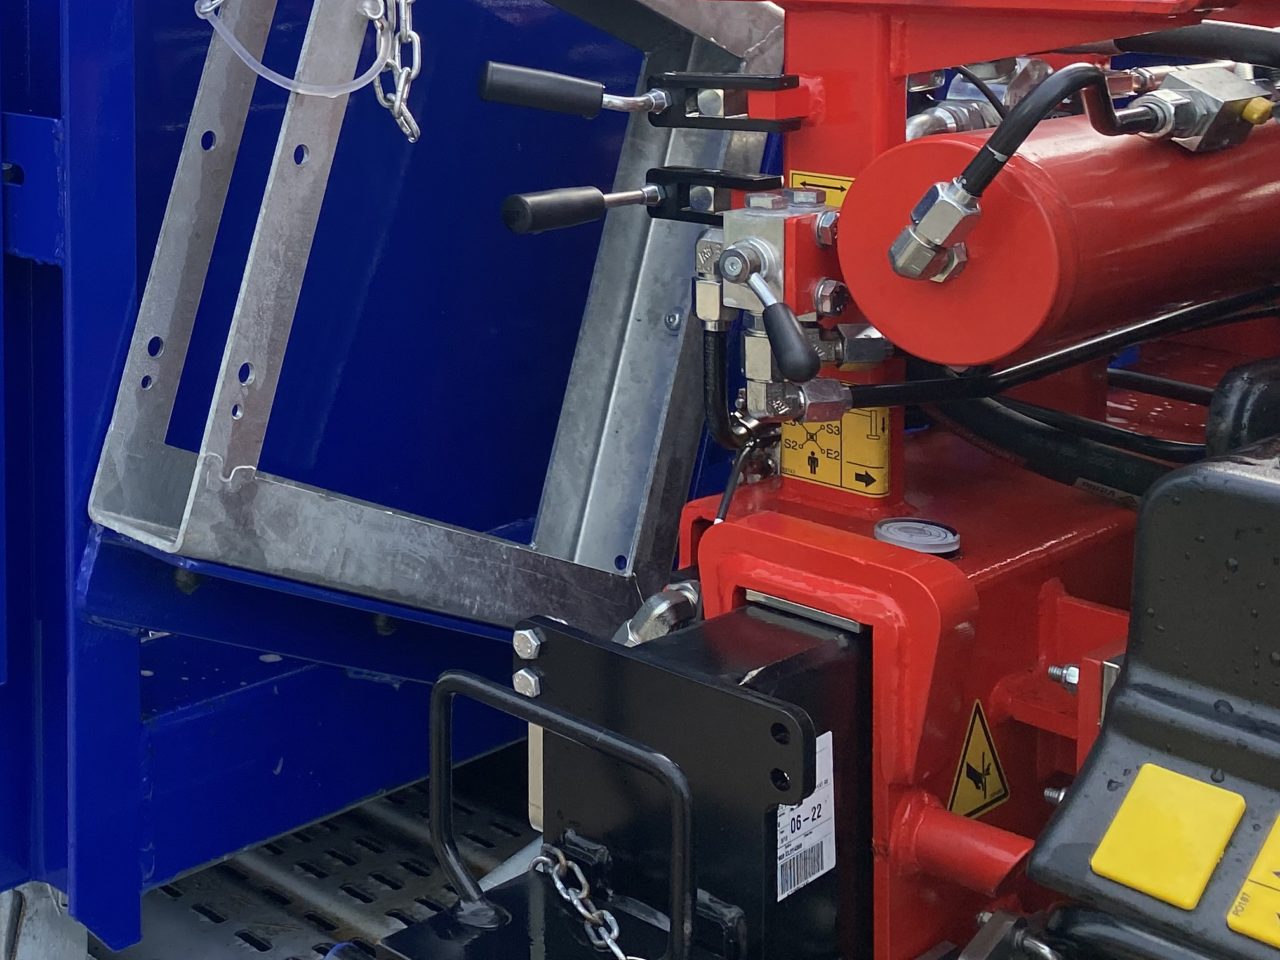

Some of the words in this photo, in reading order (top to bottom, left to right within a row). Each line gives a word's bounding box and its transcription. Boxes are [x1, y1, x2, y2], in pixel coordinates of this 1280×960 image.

[826, 423, 840, 436] S3
[784, 438, 798, 451] S2
[826, 448, 840, 461] E2
